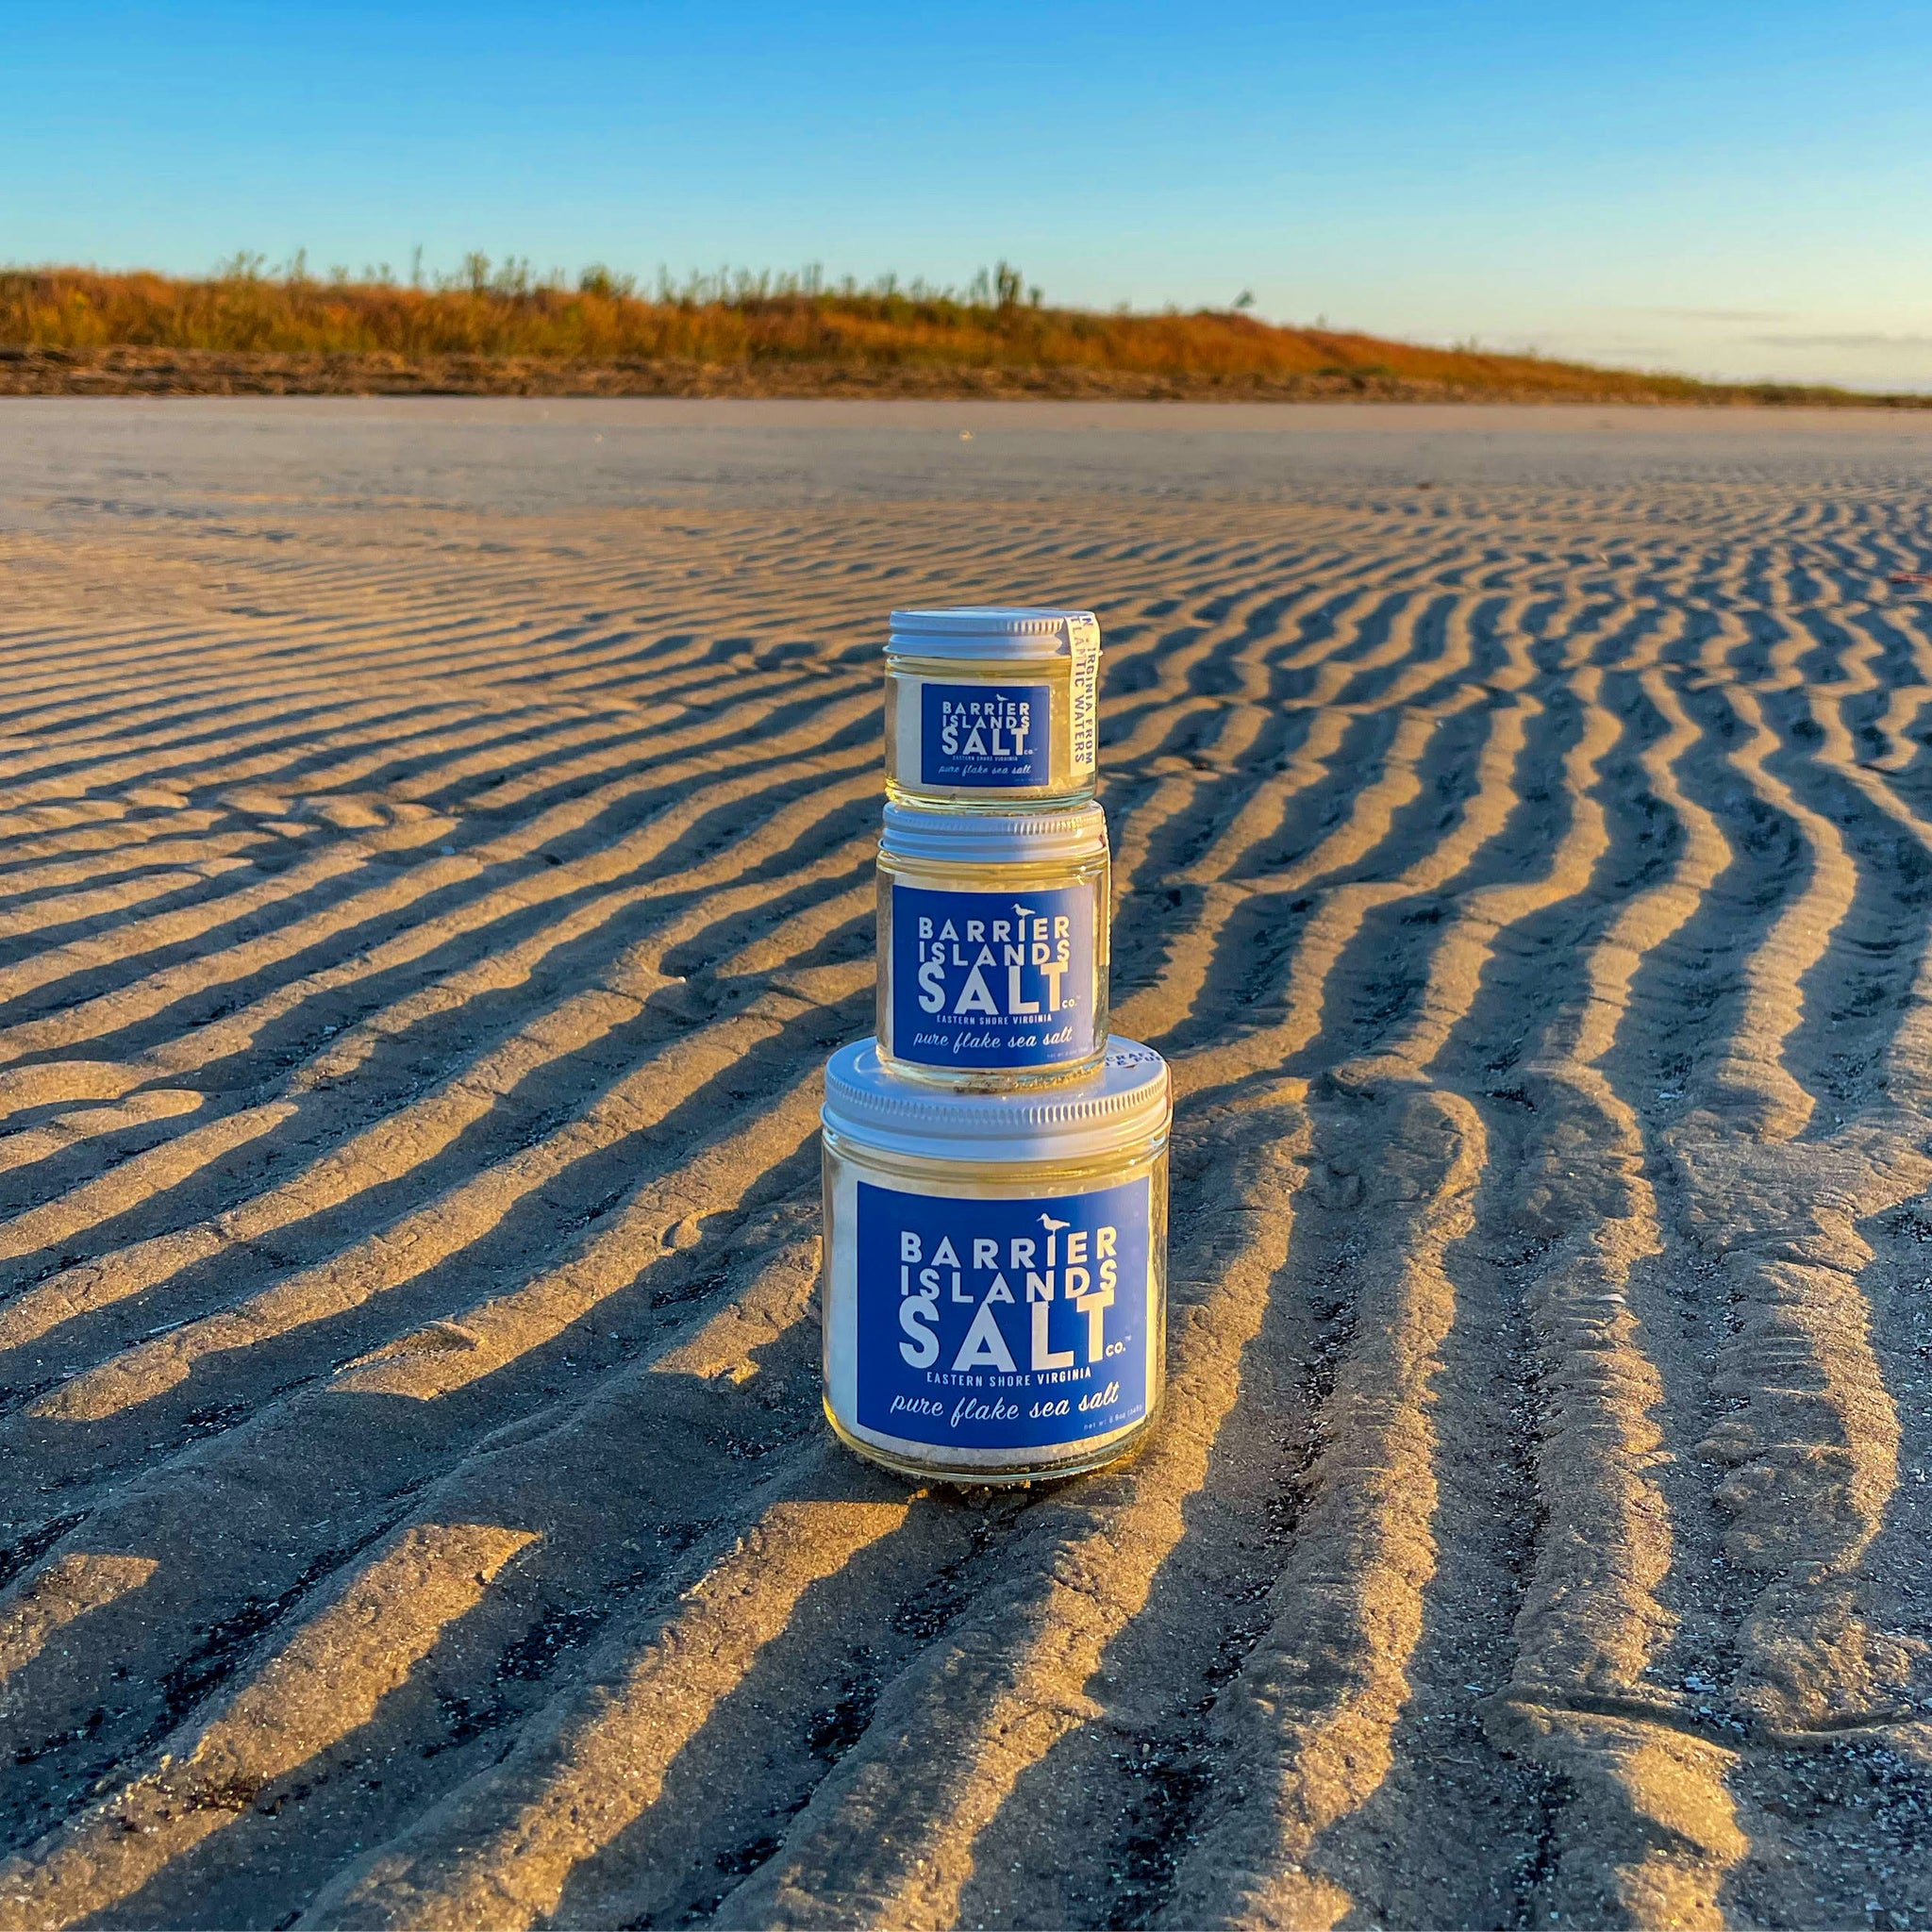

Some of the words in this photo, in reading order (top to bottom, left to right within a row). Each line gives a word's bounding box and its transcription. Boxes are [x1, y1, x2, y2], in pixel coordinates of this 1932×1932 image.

[1085, 637, 1096, 711] IRGINIA
[942, 701, 1030, 716] BARRIER
[942, 715, 1030, 729] ISLANDS
[941, 725, 1029, 756] SALT
[1074, 694, 1085, 763] WATERS
[1085, 719, 1094, 765] FROM
[939, 765, 959, 774] pure
[962, 765, 989, 777] flake
[991, 766, 1008, 774] sea
[1011, 765, 1032, 774] salt
[919, 916, 1070, 942] BARRIER
[919, 939, 1070, 967] ISLANDS
[918, 961, 1069, 1015] SALT
[937, 1014, 975, 1025] EASTERN
[979, 1016, 1008, 1025] SHORE
[1012, 1013, 1052, 1024] VIRGINIA
[912, 1032, 949, 1046] pure
[953, 1032, 1001, 1054] flake
[1008, 1035, 1037, 1048] sea
[1042, 1025, 1073, 1046] salt
[900, 1225, 1119, 1269] BARRIER
[900, 1258, 1119, 1304] ISLANDS
[899, 1291, 1115, 1372] SALT
[926, 1371, 983, 1387] EASTERN
[990, 1374, 1030, 1388] SHORE
[1037, 1367, 1091, 1385] VIRGINIA
[890, 1394, 944, 1417] pure
[950, 1395, 1019, 1428] flake
[1028, 1398, 1071, 1419] sea
[1077, 1381, 1121, 1412] salt
